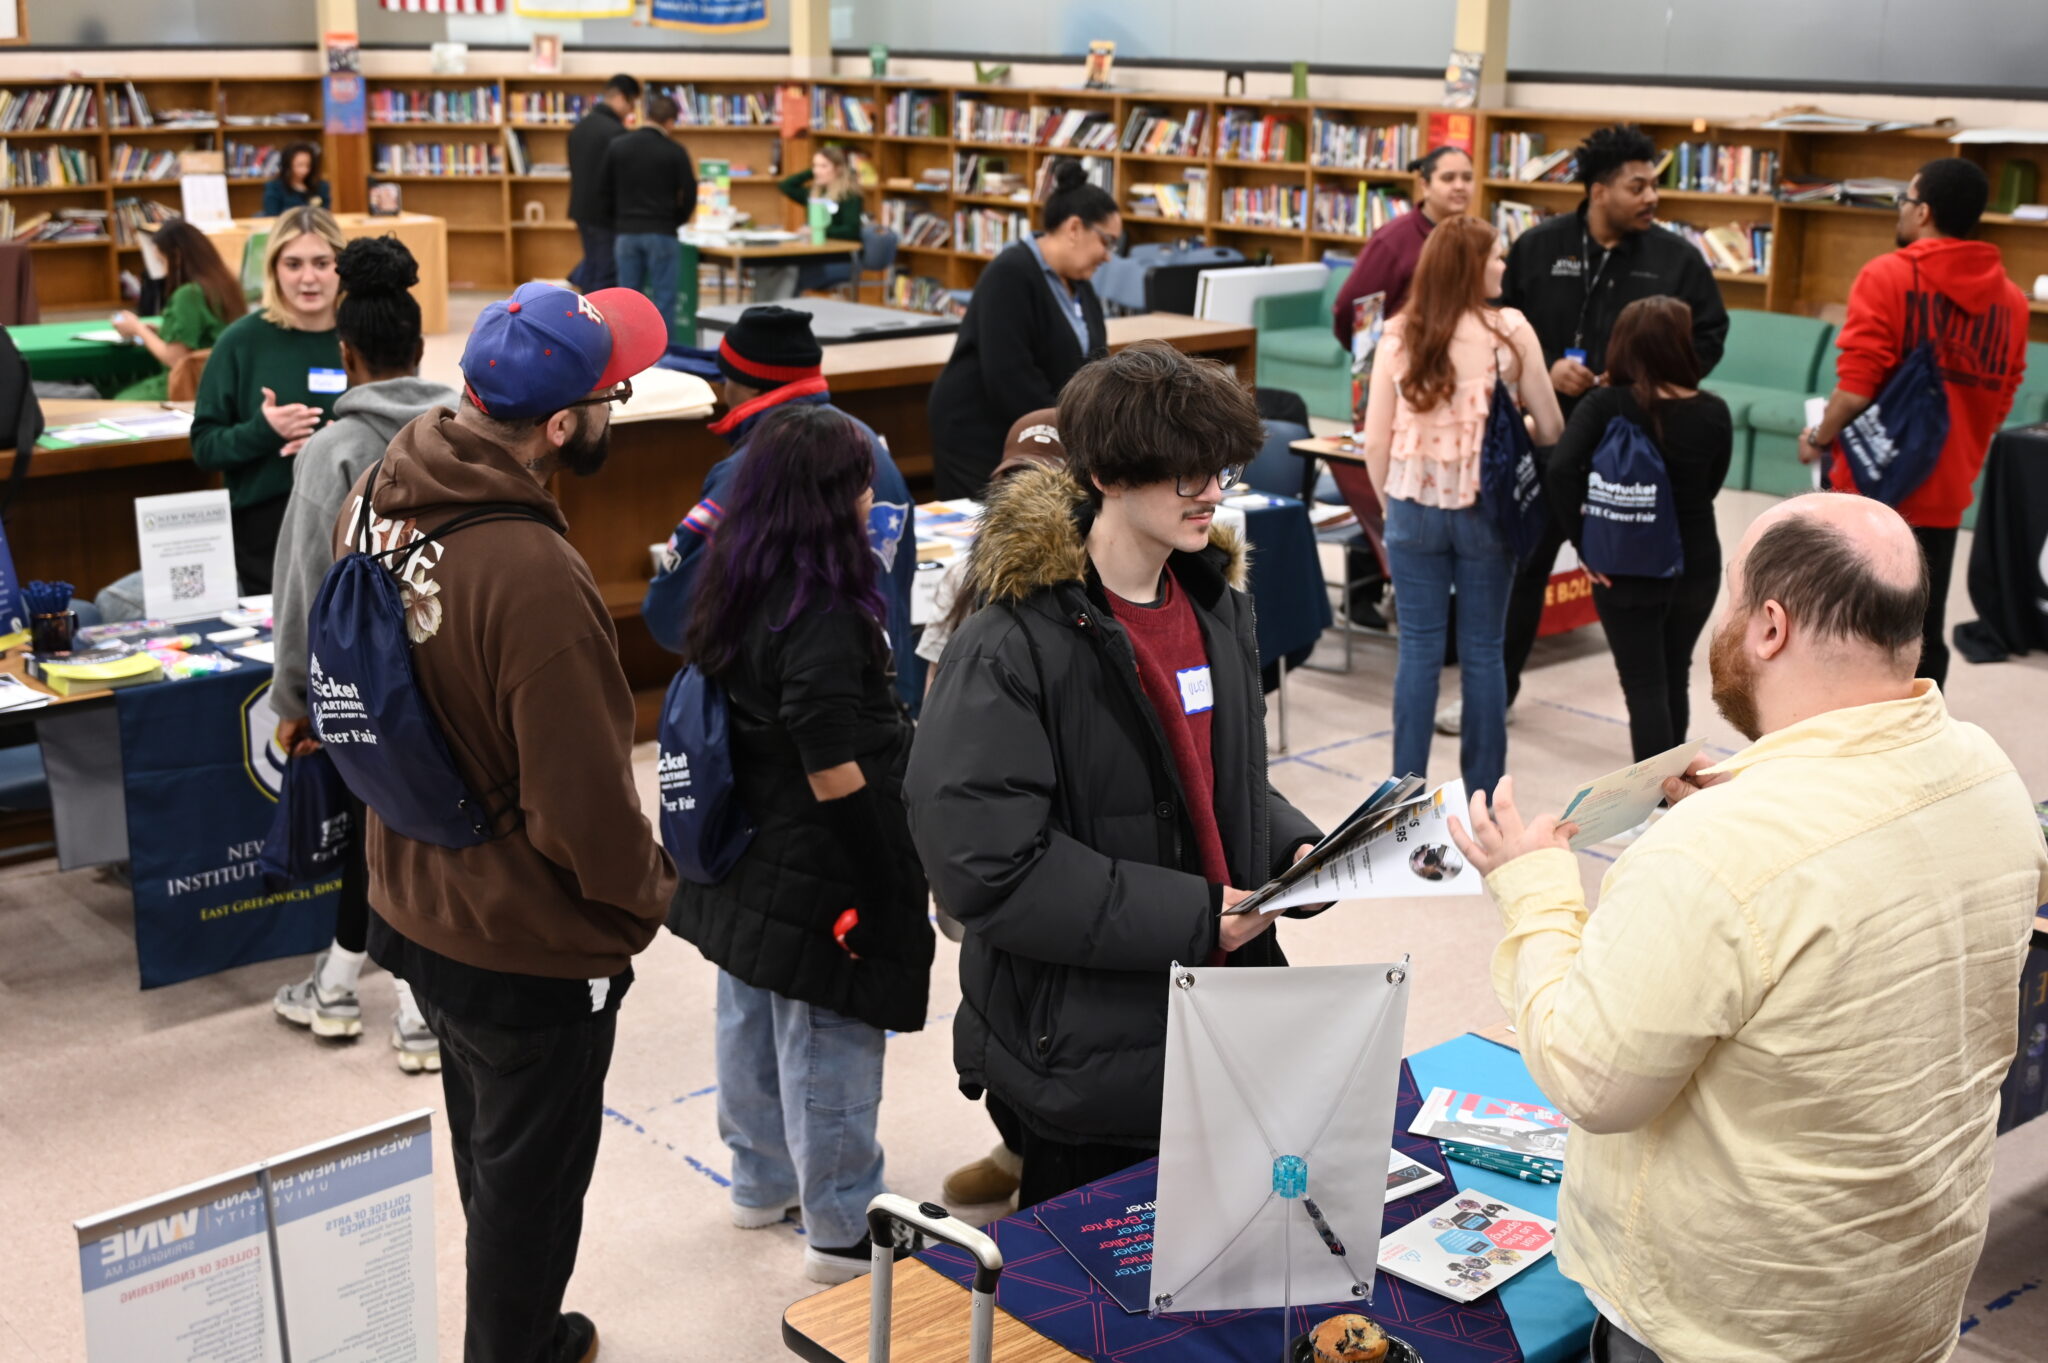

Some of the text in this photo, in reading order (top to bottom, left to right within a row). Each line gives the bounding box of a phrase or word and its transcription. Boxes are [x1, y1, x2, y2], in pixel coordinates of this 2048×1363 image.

[321, 700, 365, 711] ARTMENT
[350, 729, 378, 744] Fair
[167, 860, 263, 897] INSTITUT
[200, 904, 230, 921] EAST
[1099, 1232, 1153, 1250] iendlier
[1520, 1233, 1545, 1248] Visit
